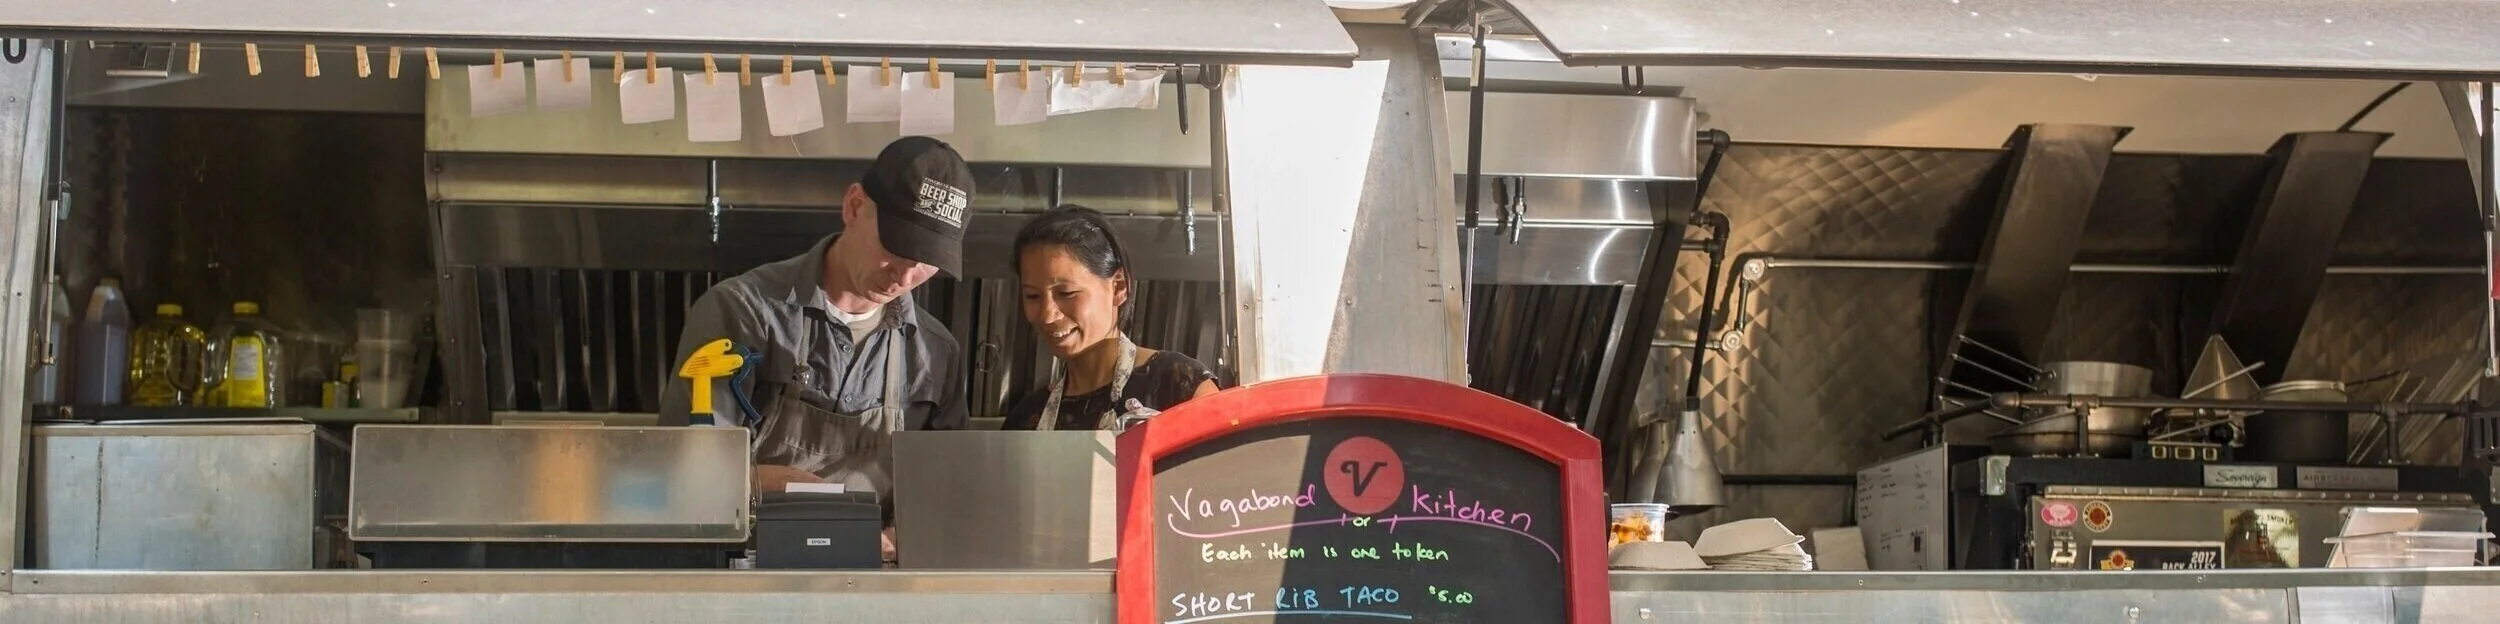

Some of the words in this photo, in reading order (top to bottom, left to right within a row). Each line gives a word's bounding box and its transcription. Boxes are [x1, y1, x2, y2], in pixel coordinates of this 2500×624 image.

[920, 182, 948, 203] BEER
[1340, 460, 1388, 497] V
[1169, 484, 1316, 527] Vagabond
[1352, 516, 1372, 527] or
[1201, 542, 1252, 563] Each
[1261, 541, 1305, 560] item
[1322, 545, 1338, 558] is
[1351, 546, 1380, 560] one
[1391, 542, 1449, 561] token
[2191, 551, 2217, 564] 2017
[1172, 592, 1255, 616] SHORT
[1339, 585, 1399, 608] TACO
